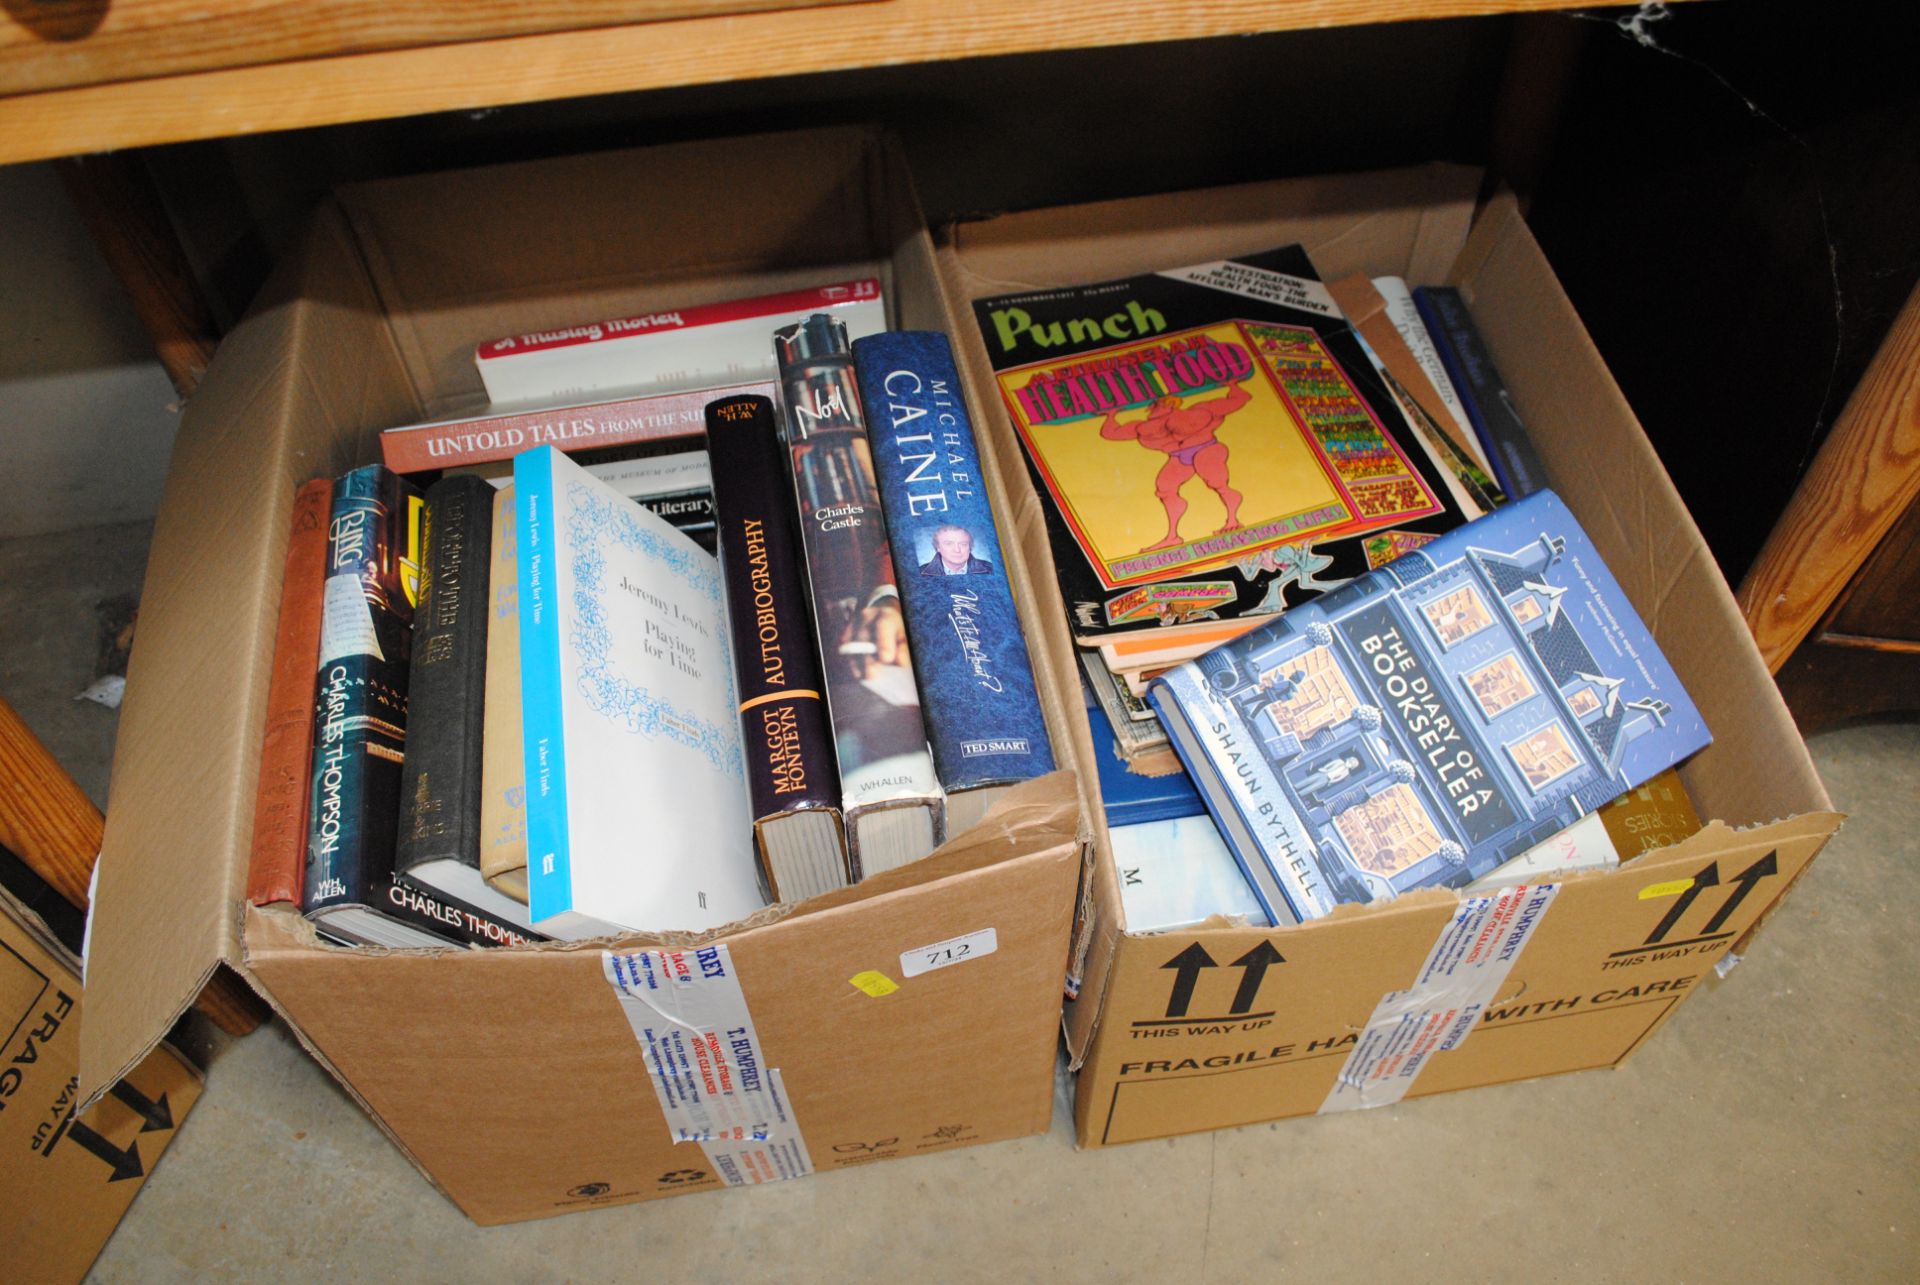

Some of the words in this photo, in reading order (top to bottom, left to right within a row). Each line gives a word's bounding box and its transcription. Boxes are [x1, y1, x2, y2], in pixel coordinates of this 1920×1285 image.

[990, 299, 1168, 352] Punch
[1283, 296, 1330, 313] BURDEN
[493, 336, 516, 352] A
[522, 321, 604, 347] Musing
[603, 310, 685, 336] Morley
[1016, 363, 1158, 426] HEALTH
[1153, 342, 1255, 396] FOOD
[717, 402, 758, 417] ALLEN
[426, 428, 525, 458] UNTOLD
[527, 417, 596, 443] TALES
[600, 417, 643, 434] FROM
[643, 412, 676, 427] THE
[884, 370, 949, 516] CAINE
[930, 379, 973, 501] MICHAEL
[651, 496, 714, 518] Literary
[814, 503, 865, 521] Charles
[820, 516, 862, 532] Castle
[1109, 545, 1190, 578] PROLONGS
[1193, 521, 1289, 558] EVERLASTING
[619, 576, 670, 617] Jeremy
[744, 519, 786, 686] AUTOBIOGRAPHY
[643, 639, 663, 660] for
[668, 649, 702, 681] Time
[644, 619, 697, 663] Playing
[321, 665, 348, 748] CHARLES
[1360, 634, 1480, 817] BOOKSELLER
[1382, 626, 1416, 672] THE
[1410, 676, 1461, 742] DIARY
[1456, 751, 1484, 780] OF
[1476, 788, 1494, 805] A
[763, 710, 791, 795] MARGOT
[779, 706, 807, 791] FONTEYN
[963, 741, 987, 754] TED
[987, 740, 1027, 753] SMART
[319, 747, 344, 854] THOMPSON
[1212, 721, 1262, 795] SHAUN
[1257, 800, 1321, 898] BYTHELL
[312, 885, 346, 903] ALLEN
[389, 886, 462, 928] CHARLES
[1496, 896, 1548, 962] HUMPHREY
[926, 944, 971, 965] 712
[1602, 955, 1648, 971] THIS
[1649, 946, 1697, 965] WAY
[1697, 940, 1729, 955] UP
[1482, 994, 1582, 1024] WITH
[1589, 974, 1698, 1004] CARE
[0, 987, 74, 1113] FRAG
[691, 1036, 707, 1059] HOUSE
[1130, 1026, 1181, 1039] THIS
[1185, 1024, 1239, 1036] WAY
[1241, 1018, 1273, 1031] UP
[698, 1058, 718, 1095] CLEARANCES
[717, 1065, 734, 1091] STORAGE
[730, 1038, 763, 1093] HUMPHREY
[1119, 1044, 1297, 1076] FRAGILE
[30, 1121, 52, 1153] UP
